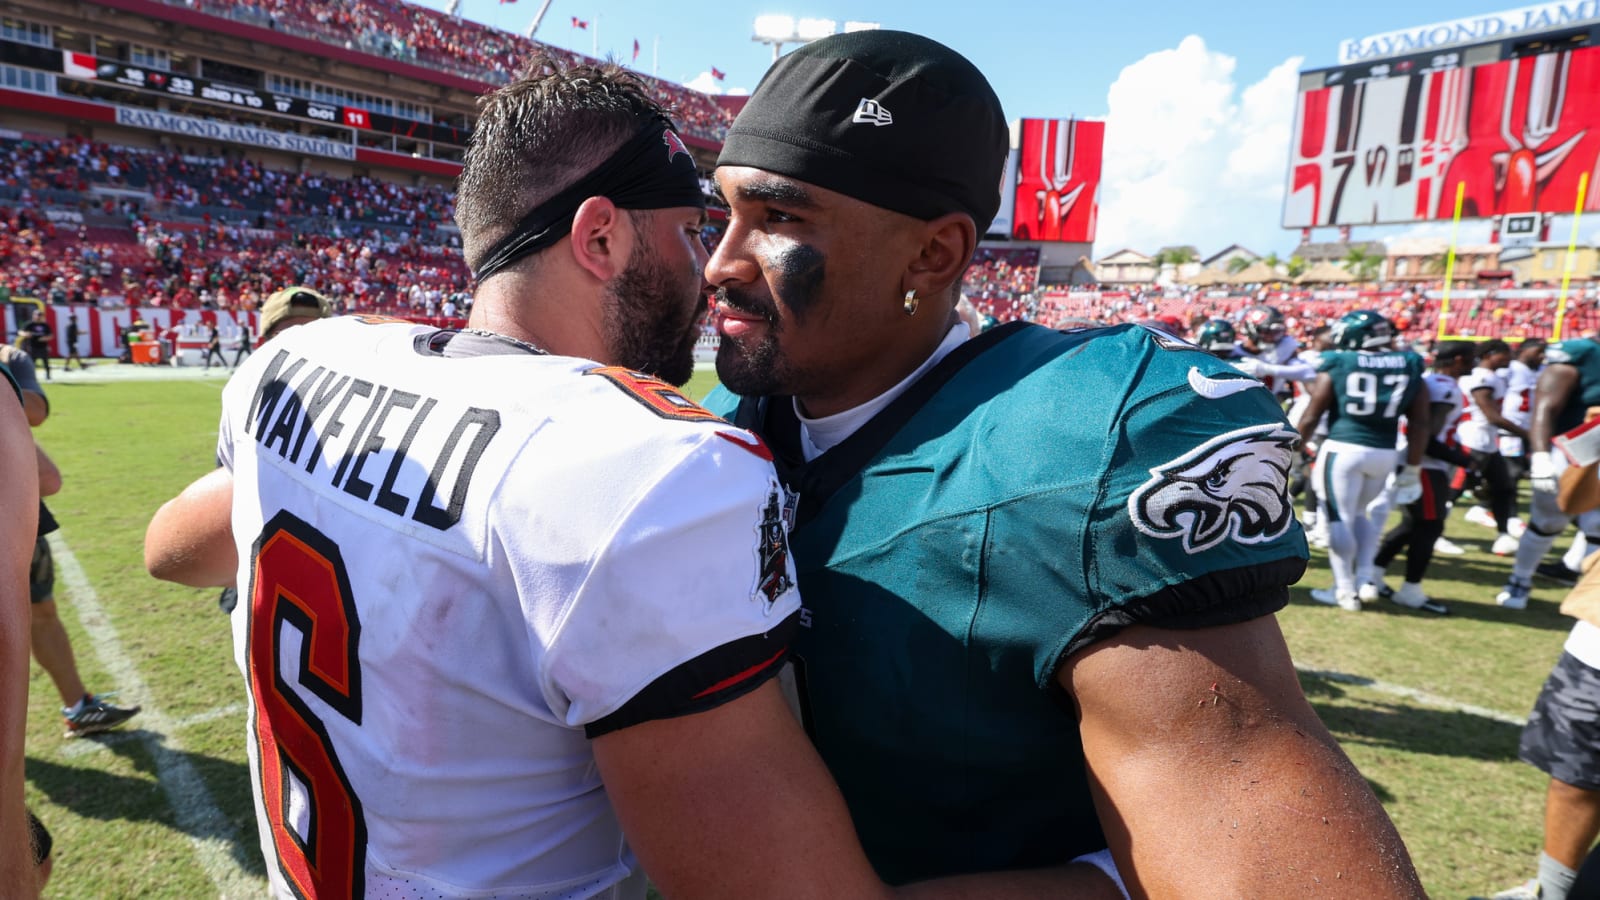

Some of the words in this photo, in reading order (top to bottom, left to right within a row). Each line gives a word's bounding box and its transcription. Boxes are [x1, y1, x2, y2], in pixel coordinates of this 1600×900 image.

[1346, 17, 1504, 59] RAYMOND
[201, 87, 232, 102] 2ND
[246, 95, 263, 108] 10
[347, 112, 363, 125] 11
[119, 108, 221, 137] RAYMOND
[223, 126, 281, 147] JAMES
[285, 135, 354, 157] STADIUM
[1345, 372, 1410, 418] 97
[244, 349, 501, 531] MAYFIELD
[246, 508, 368, 900] 6
